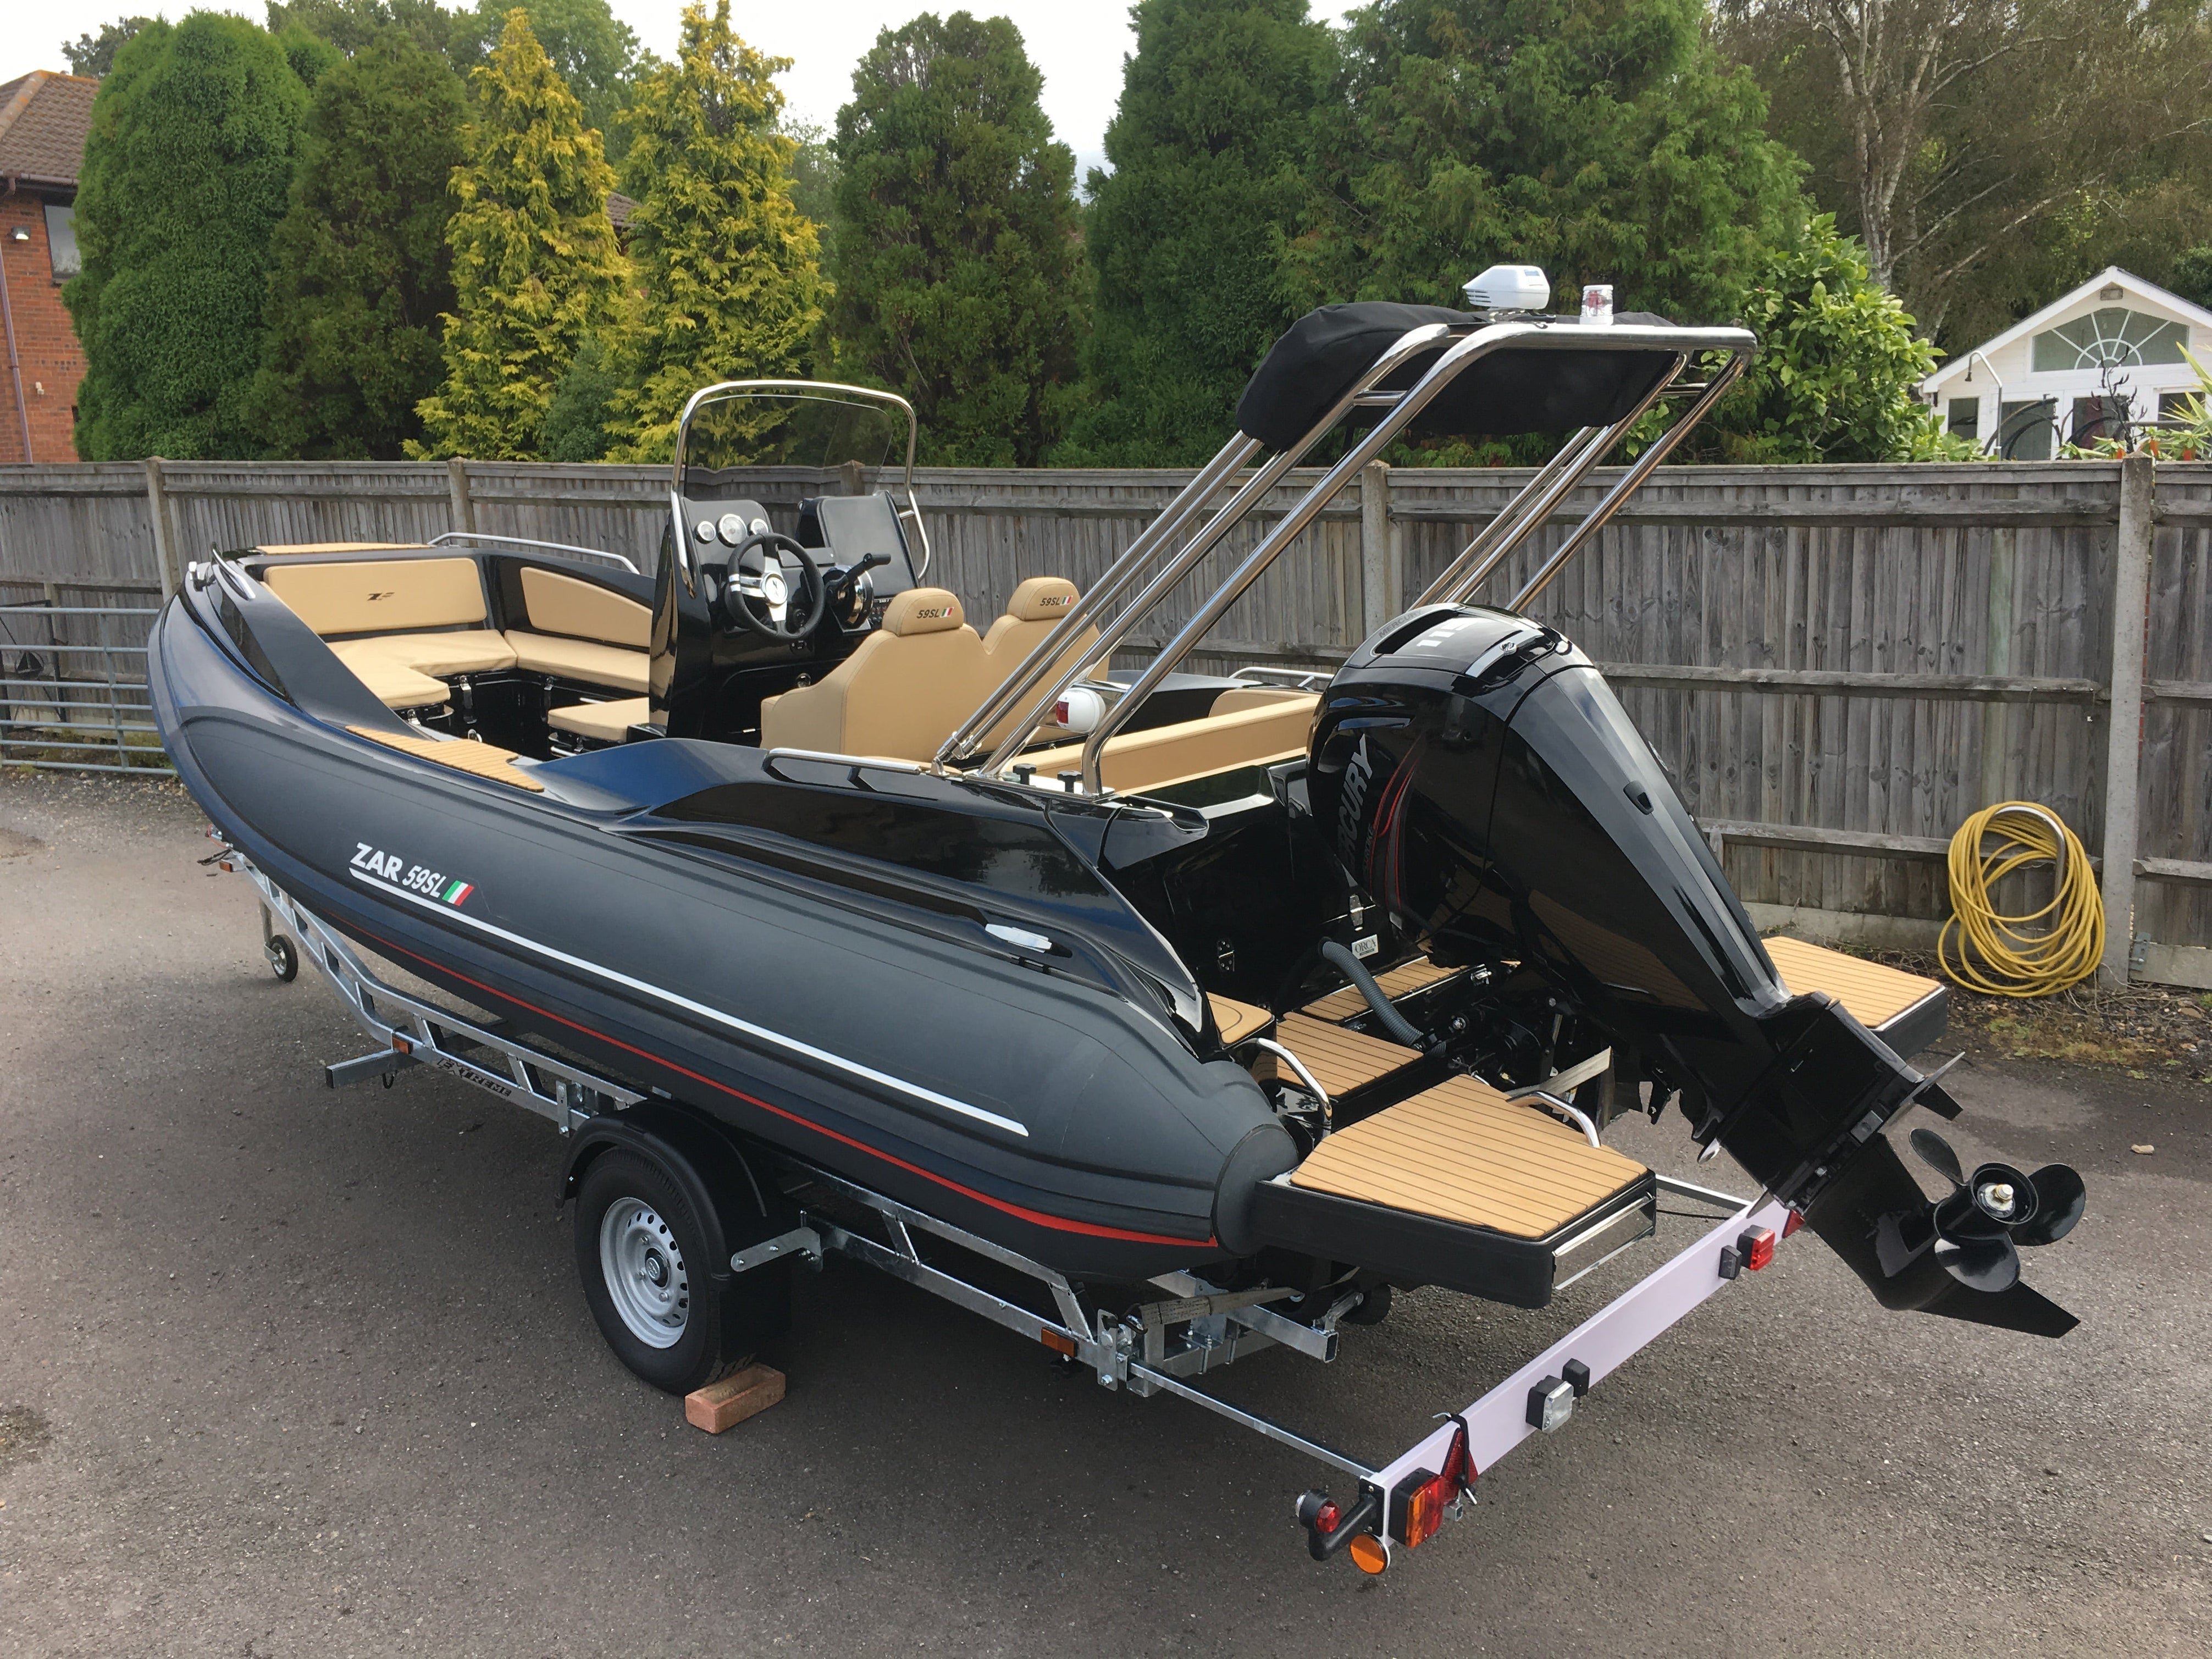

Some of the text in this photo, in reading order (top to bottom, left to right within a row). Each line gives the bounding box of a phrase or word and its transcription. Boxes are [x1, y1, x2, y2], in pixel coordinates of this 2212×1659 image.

[1039, 597, 1060, 606] 59SL
[916, 609, 939, 619] 59SL
[1378, 610, 1421, 638] MERCURY
[350, 842, 447, 898] ZAR 59SL
[1355, 939, 1376, 953] ORCA
[437, 1058, 512, 1097] EXTREME
